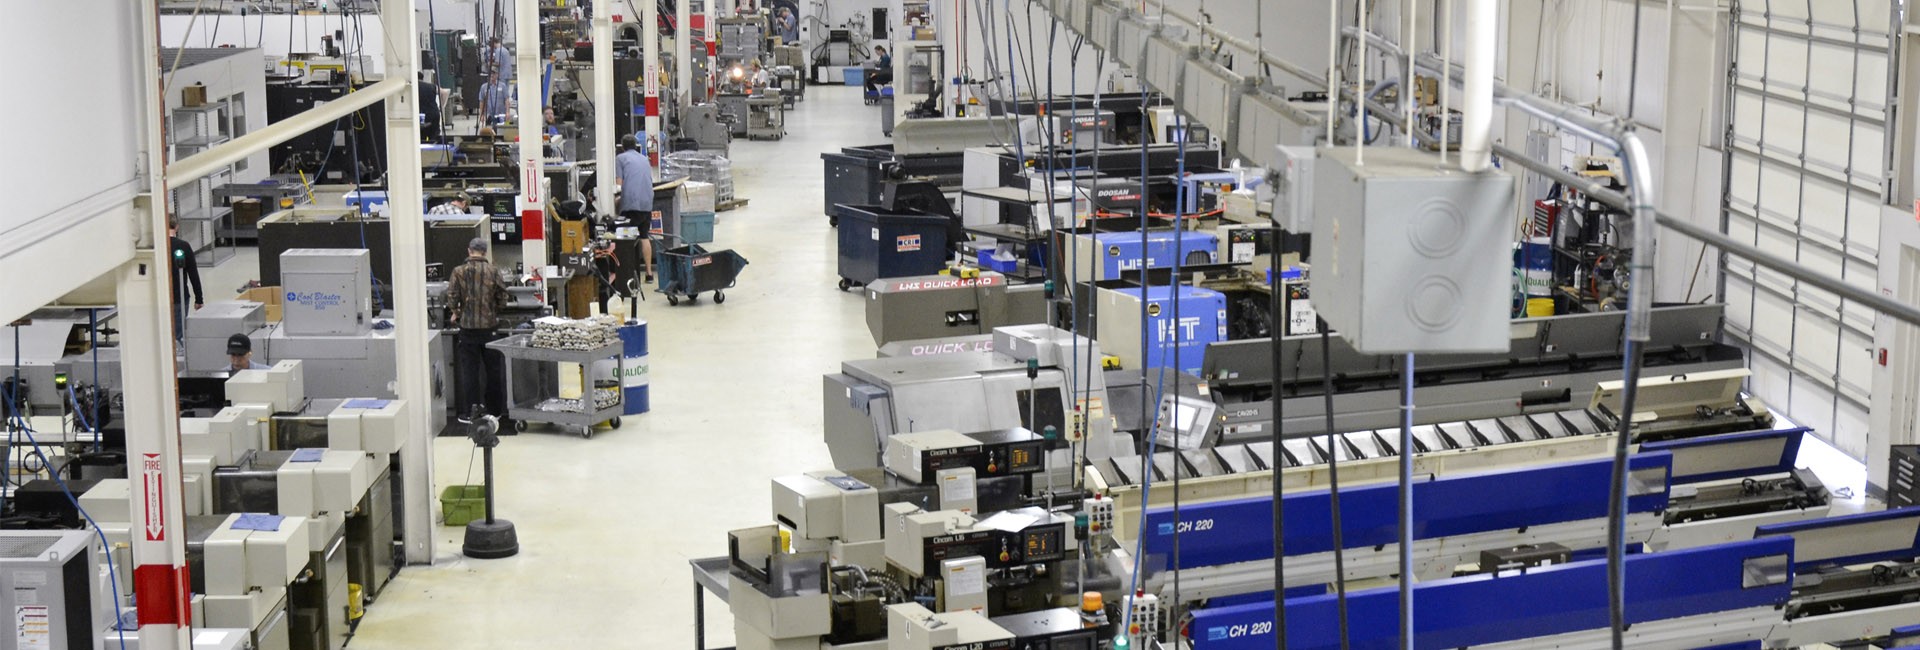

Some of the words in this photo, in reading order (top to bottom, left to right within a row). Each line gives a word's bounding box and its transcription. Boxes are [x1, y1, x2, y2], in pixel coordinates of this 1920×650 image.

[1098, 189, 1129, 197] DOOSAN
[903, 238, 915, 246] CRI
[923, 280, 958, 289] QUICK
[960, 277, 992, 287] LOAD
[911, 342, 966, 356] QUICK
[974, 340, 994, 352] LO
[930, 449, 948, 457] Cincom
[144, 460, 161, 470] FIRE
[1177, 520, 1193, 533] CH
[1194, 518, 1214, 531] 220
[933, 535, 954, 544] Cincom
[954, 533, 965, 542] L16
[1229, 623, 1248, 638] CH
[1250, 621, 1272, 635] 220
[969, 642, 984, 650] L20
